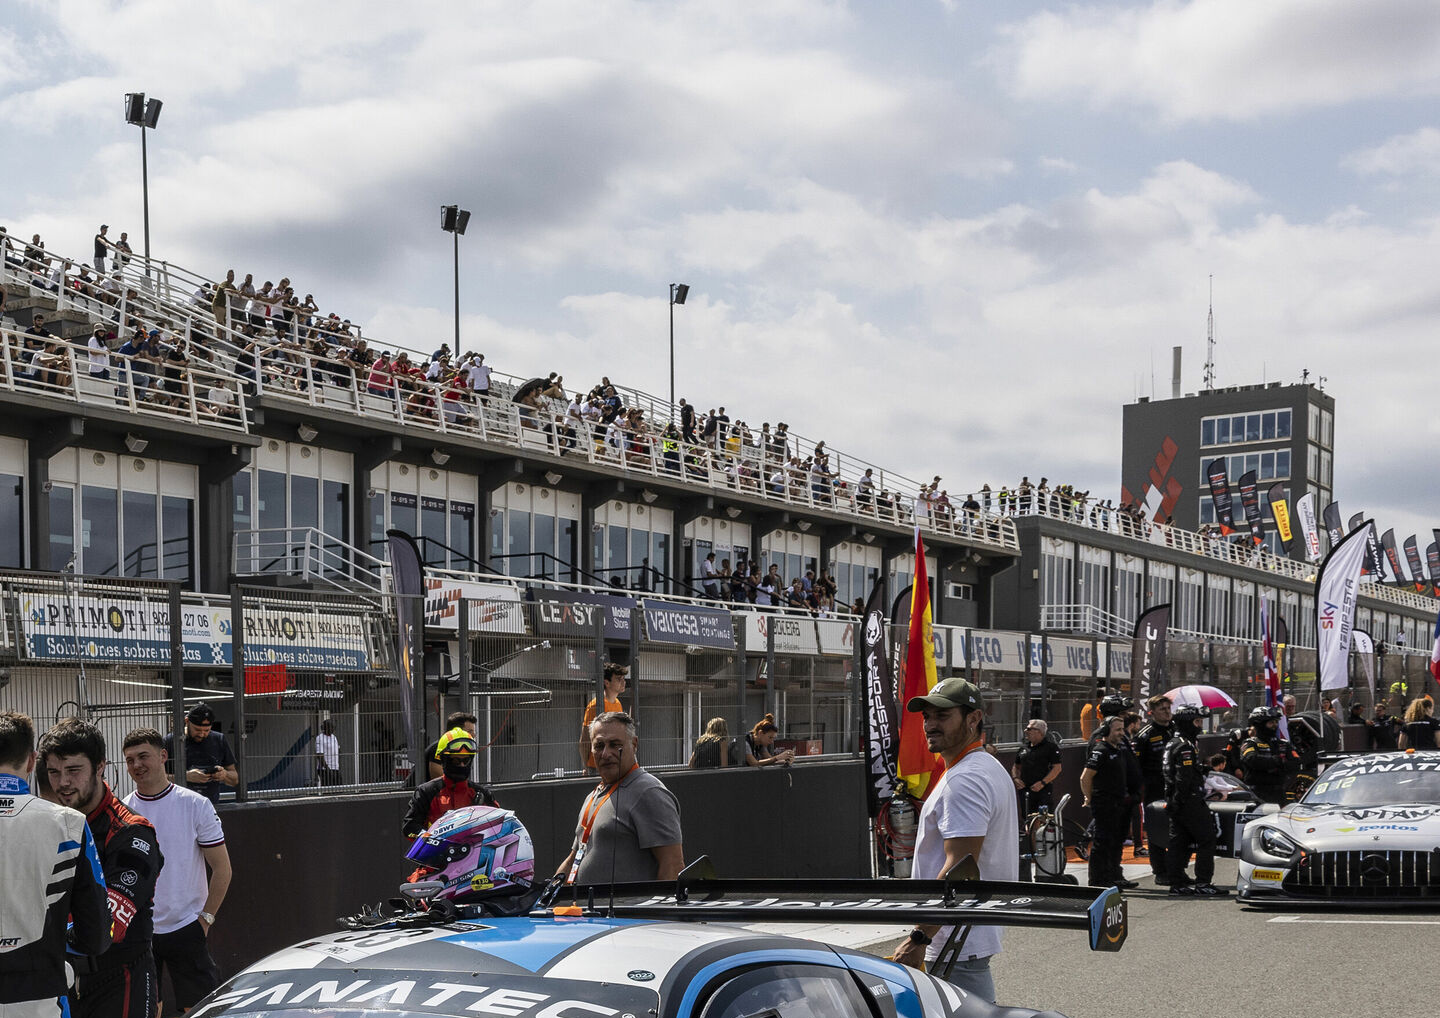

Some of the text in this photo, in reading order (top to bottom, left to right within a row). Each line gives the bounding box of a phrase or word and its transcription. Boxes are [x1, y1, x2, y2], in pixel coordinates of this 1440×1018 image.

[47, 604, 147, 632] PRIMOTI
[184, 614, 195, 626] 27
[614, 618, 628, 629] Store
[1320, 601, 1338, 629] sky
[1340, 578, 1354, 651] TEMPESTA
[244, 616, 315, 640] RIMOTI
[124, 642, 158, 659] sobre
[866, 651, 894, 799] MADPANDA
[438, 824, 454, 834] BWT
[132, 840, 150, 851] OMP
[1106, 903, 1123, 929] aws
[870, 984, 887, 996] WRT
